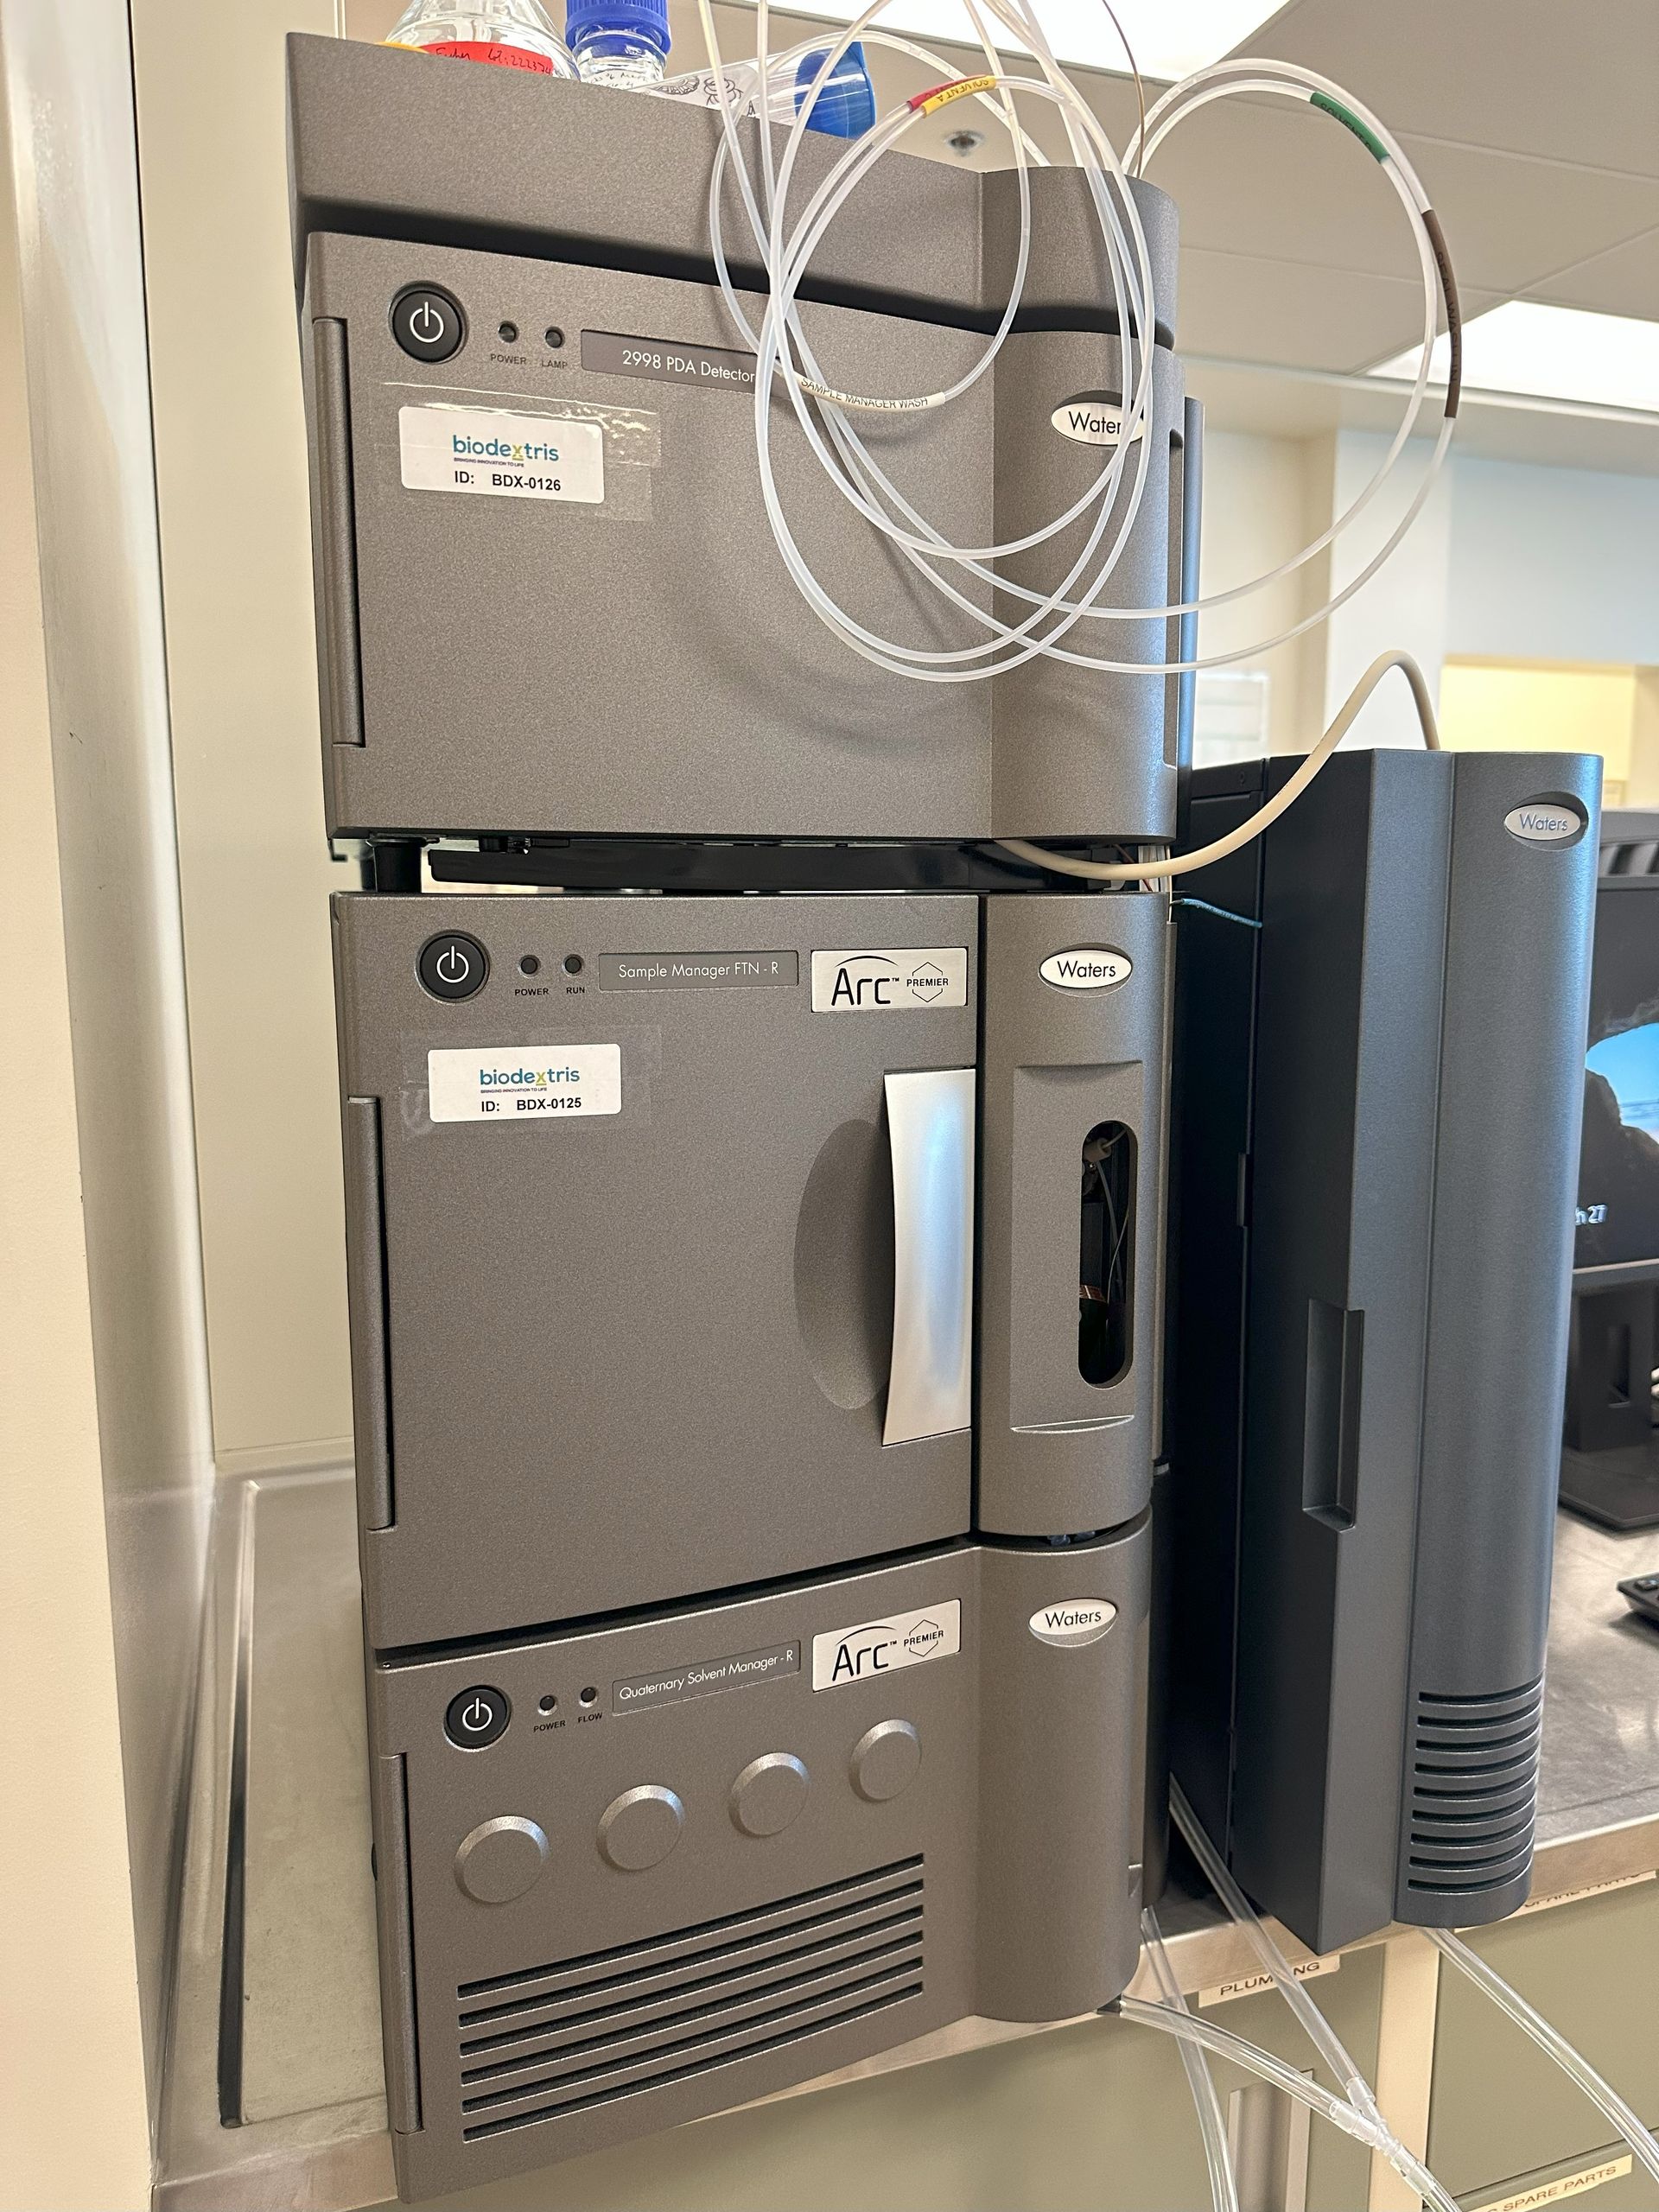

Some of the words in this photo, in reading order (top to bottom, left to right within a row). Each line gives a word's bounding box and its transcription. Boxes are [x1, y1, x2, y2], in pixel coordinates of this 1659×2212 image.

[490, 353, 527, 365] POWER
[542, 359, 568, 369] LAMP
[622, 350, 661, 369] 2998
[667, 356, 696, 374] PDA
[701, 361, 755, 383] Detector
[801, 378, 842, 401] SAMPLE
[845, 394, 896, 409] MANAGER
[899, 397, 928, 409] WASH
[1068, 410, 1122, 434] Water
[453, 435, 559, 461] biodextris
[454, 470, 474, 484] ID:
[492, 474, 561, 491] BDX-0126
[1519, 813, 1568, 831] Waters
[619, 963, 667, 981] Sample
[671, 963, 730, 980] Manager
[734, 962, 760, 975] FTN
[771, 961, 779, 975] R
[1057, 960, 1116, 979] Waters
[514, 988, 549, 996] POWER
[906, 977, 949, 987] PREMIER
[480, 1066, 580, 1086] biodextris
[481, 1101, 499, 1112] ID:
[517, 1097, 582, 1110] BDX-0125
[1045, 1610, 1102, 1629] Waters
[903, 1630, 944, 1647] PREMIER
[620, 1678, 684, 1700] Quaternary
[688, 1667, 726, 1684] Solvent
[728, 1656, 778, 1675] Manager
[786, 1649, 793, 1661] R
[533, 1719, 566, 1732] POWER
[577, 1712, 602, 1723] FLOW
[1220, 1961, 1320, 1995] PLUMNG
[1503, 2186, 1558, 2212] SPARE
[1564, 2165, 1617, 2190] PARTS
